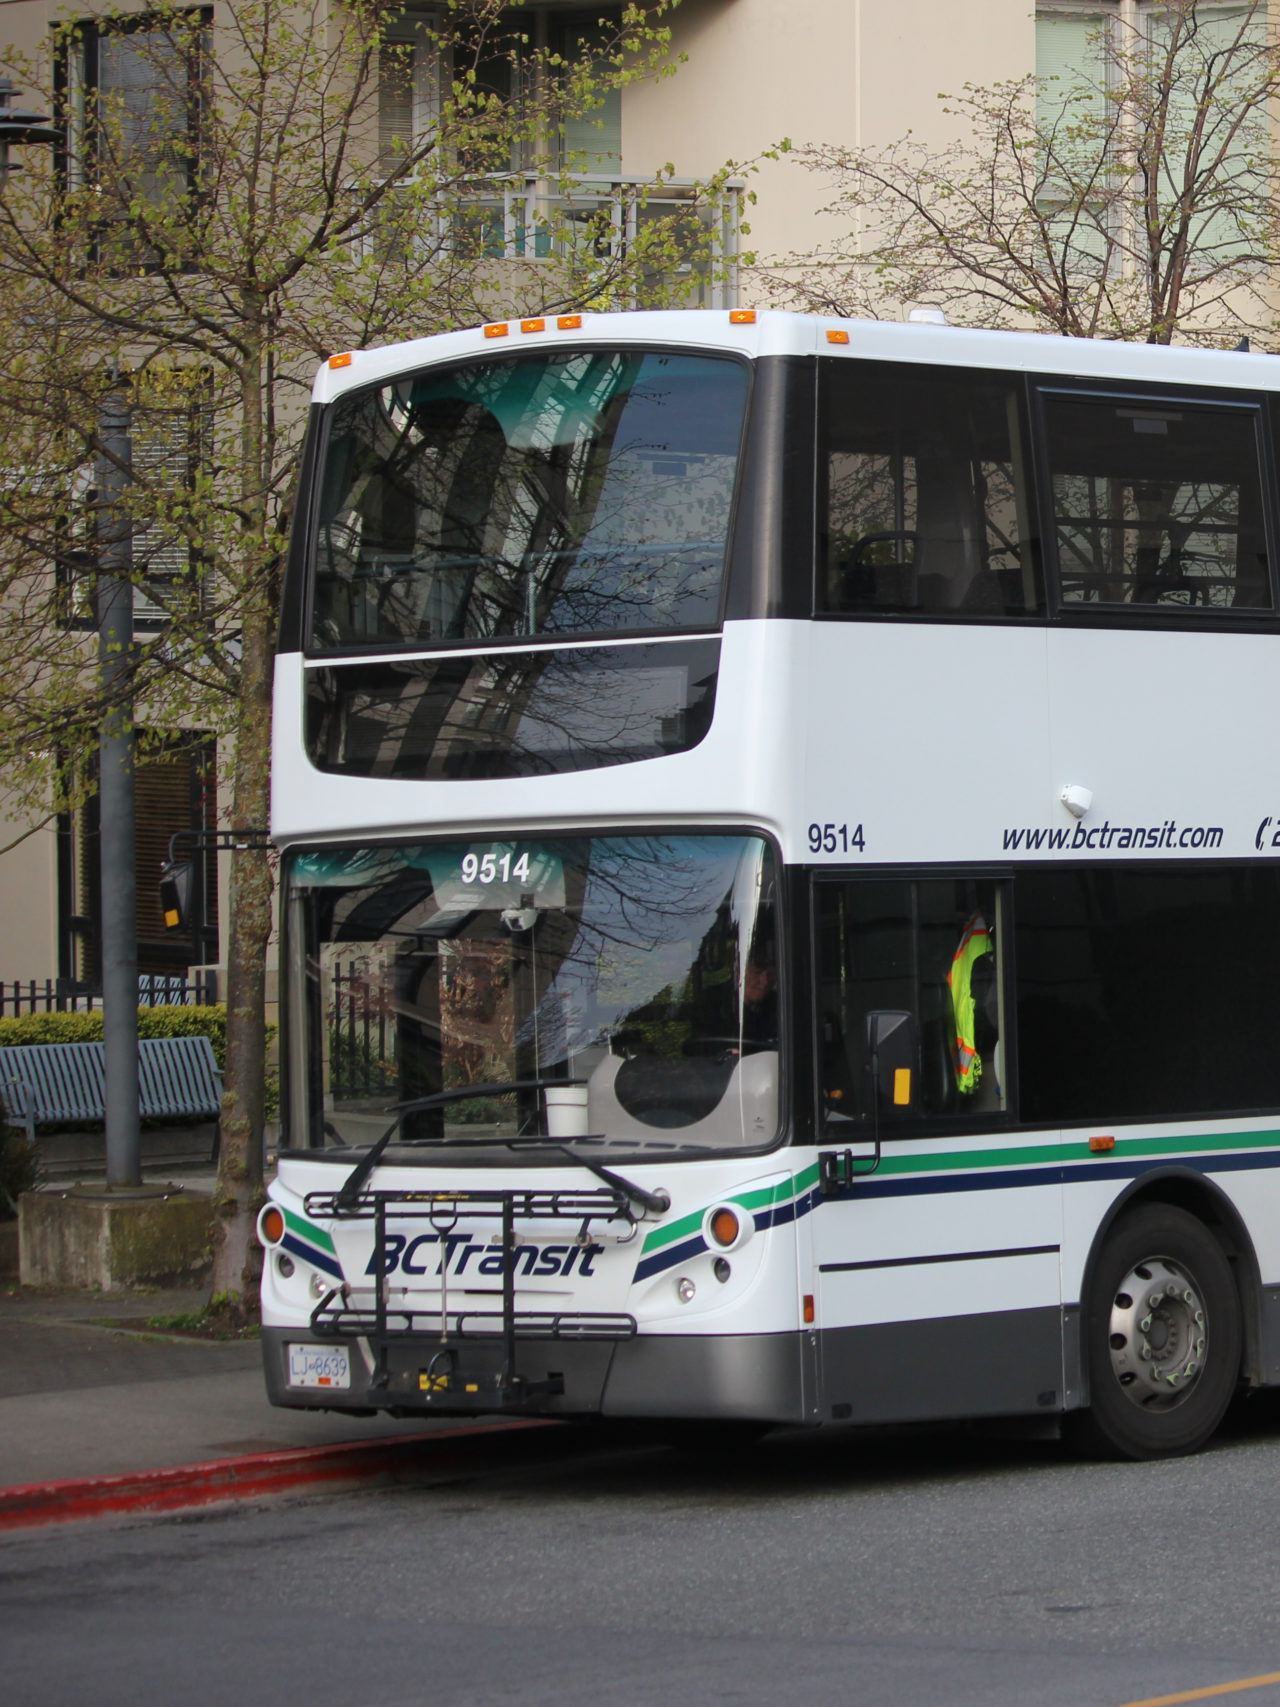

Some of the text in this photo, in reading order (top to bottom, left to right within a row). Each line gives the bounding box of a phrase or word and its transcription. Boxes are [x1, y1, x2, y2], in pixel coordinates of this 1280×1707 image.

[808, 823, 865, 853] 9514
[1003, 821, 1224, 850] www.bctransit.com
[461, 853, 530, 884] 9514
